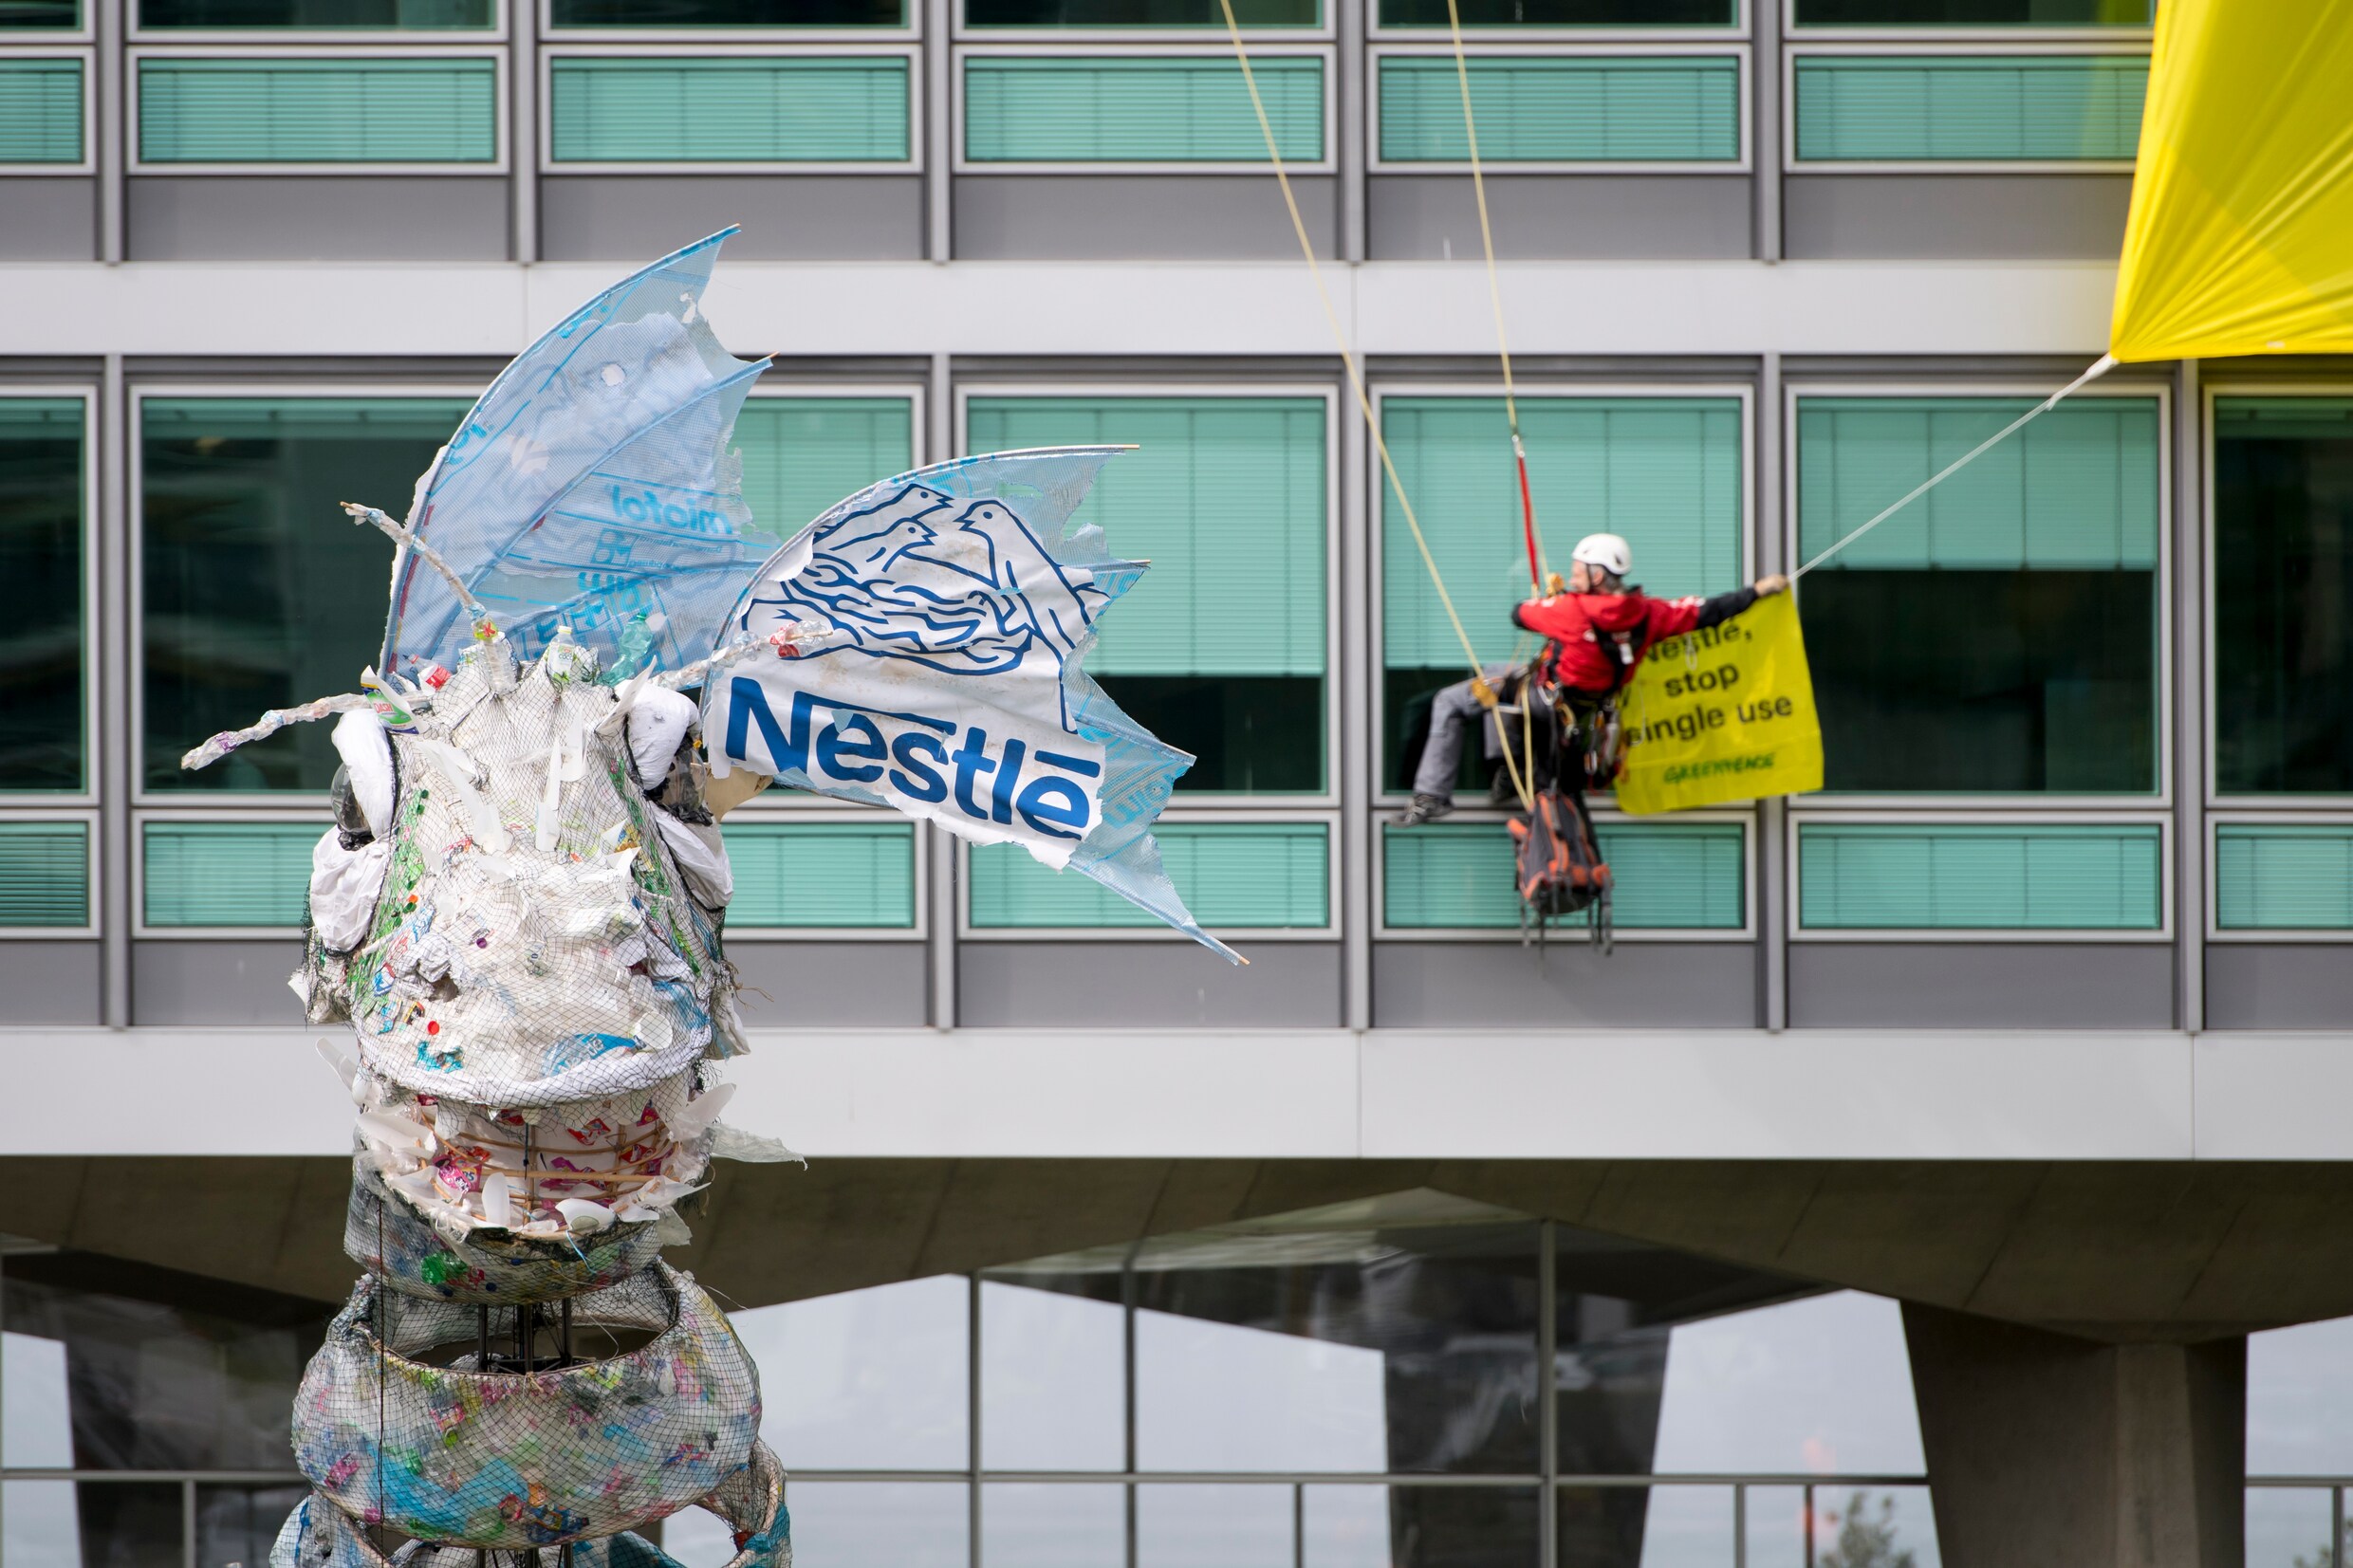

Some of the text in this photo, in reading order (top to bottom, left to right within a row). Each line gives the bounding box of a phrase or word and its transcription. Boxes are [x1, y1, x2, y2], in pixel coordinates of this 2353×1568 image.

[1664, 664, 1740, 698] stop
[373, 702, 394, 713] DASH
[1737, 696, 1792, 724] use
